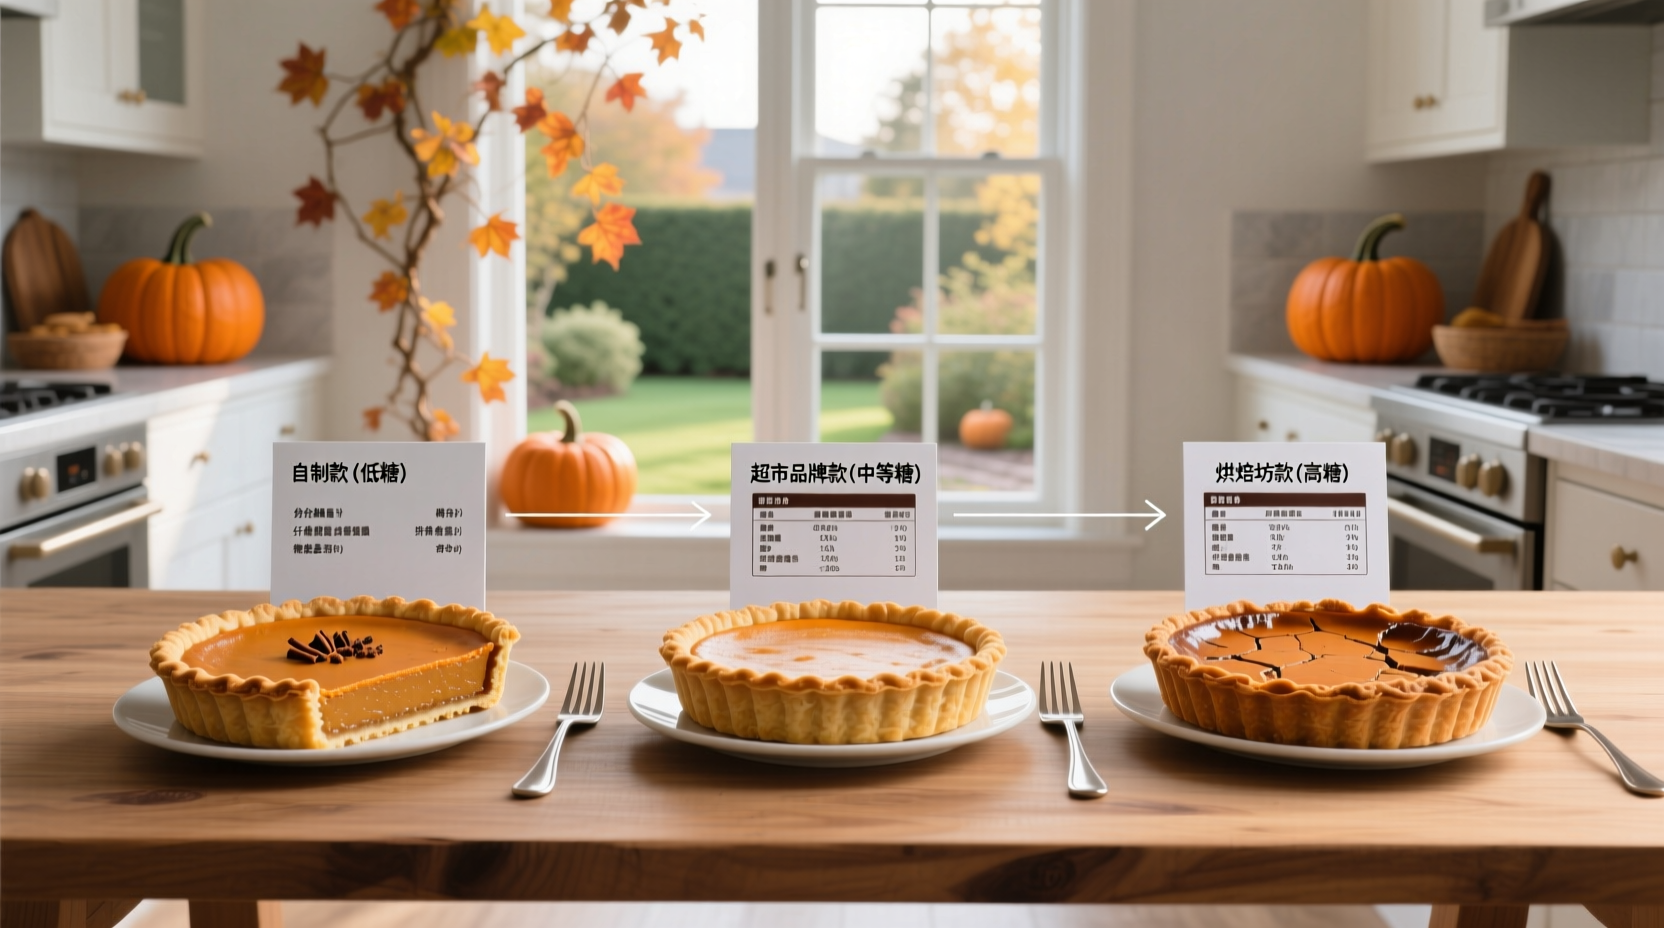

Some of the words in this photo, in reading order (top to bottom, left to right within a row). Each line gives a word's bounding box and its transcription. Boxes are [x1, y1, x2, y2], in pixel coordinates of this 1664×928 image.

[292, 461, 407, 484] 自制款(低糖)
[750, 461, 921, 485] 超市品牌款(中等糖)
[1215, 461, 1349, 484] 烘焙坊款(高糖)
